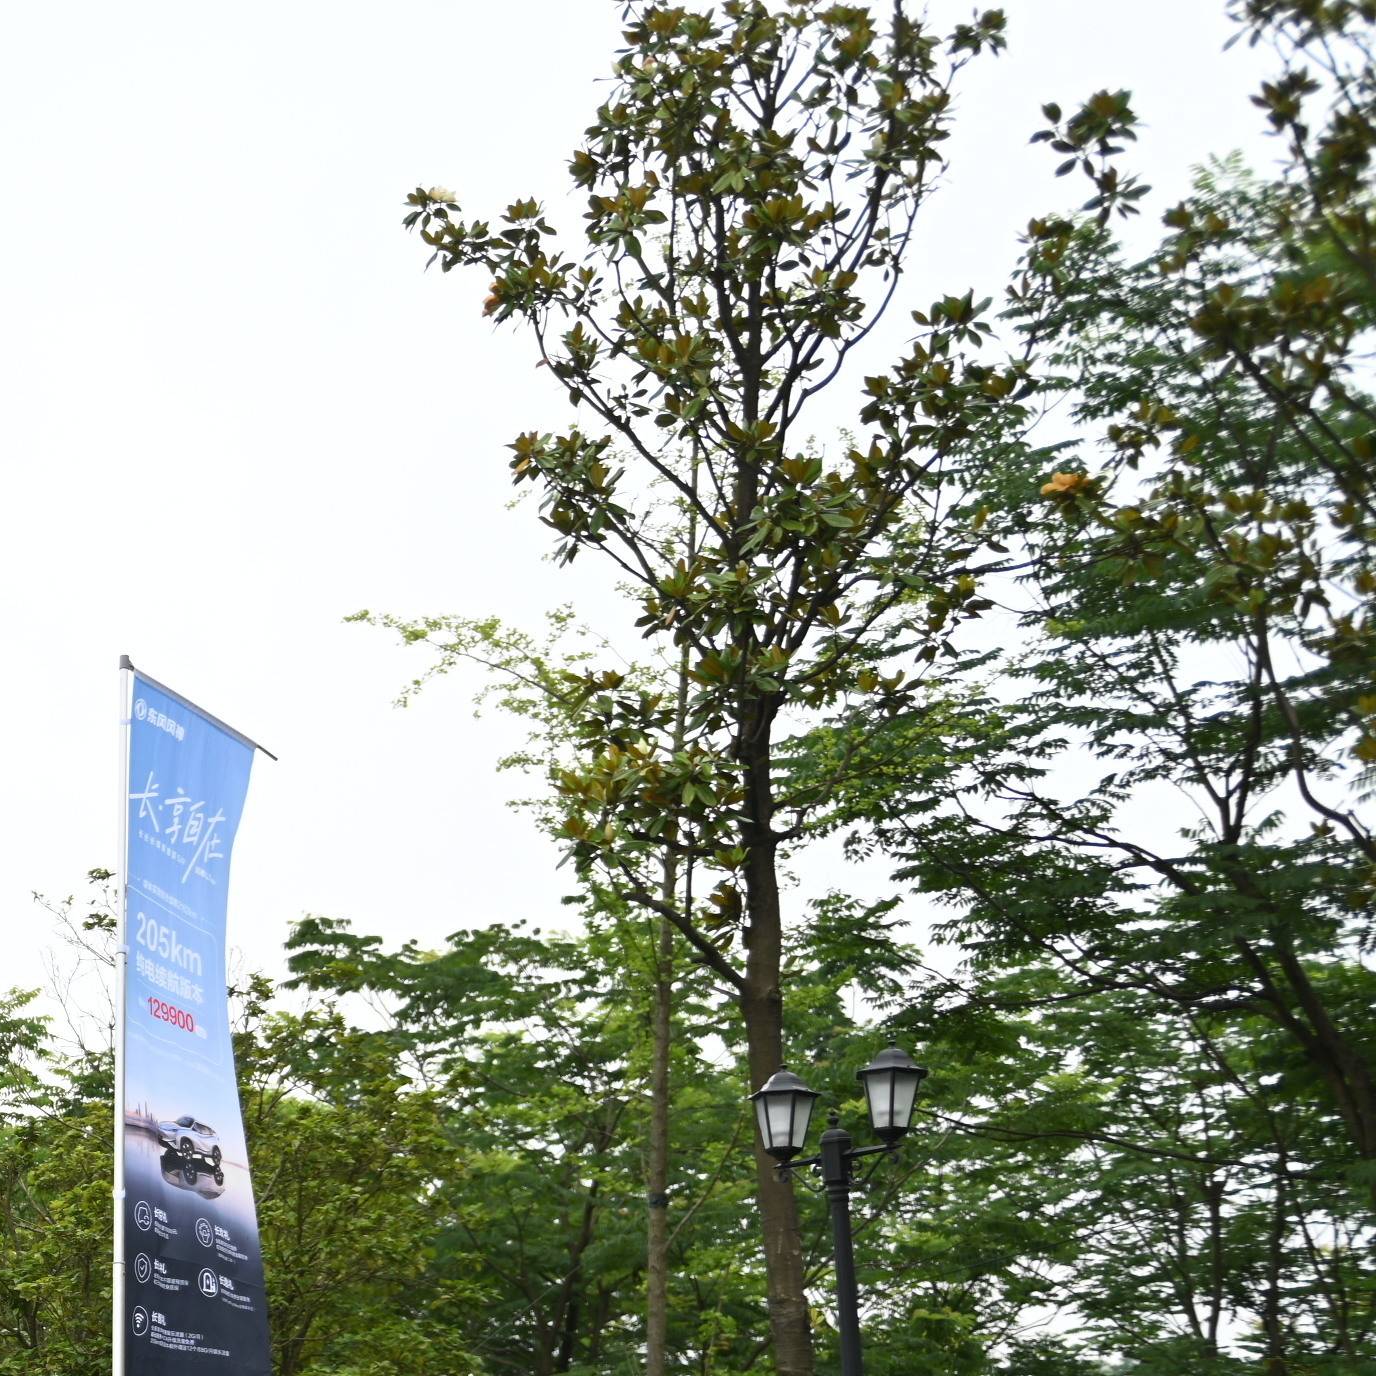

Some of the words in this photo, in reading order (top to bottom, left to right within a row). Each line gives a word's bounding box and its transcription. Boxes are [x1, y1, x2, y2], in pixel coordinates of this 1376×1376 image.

[147, 707, 186, 742] 东风风神
[135, 911, 203, 977] 205km
[147, 996, 195, 1033] 129900
